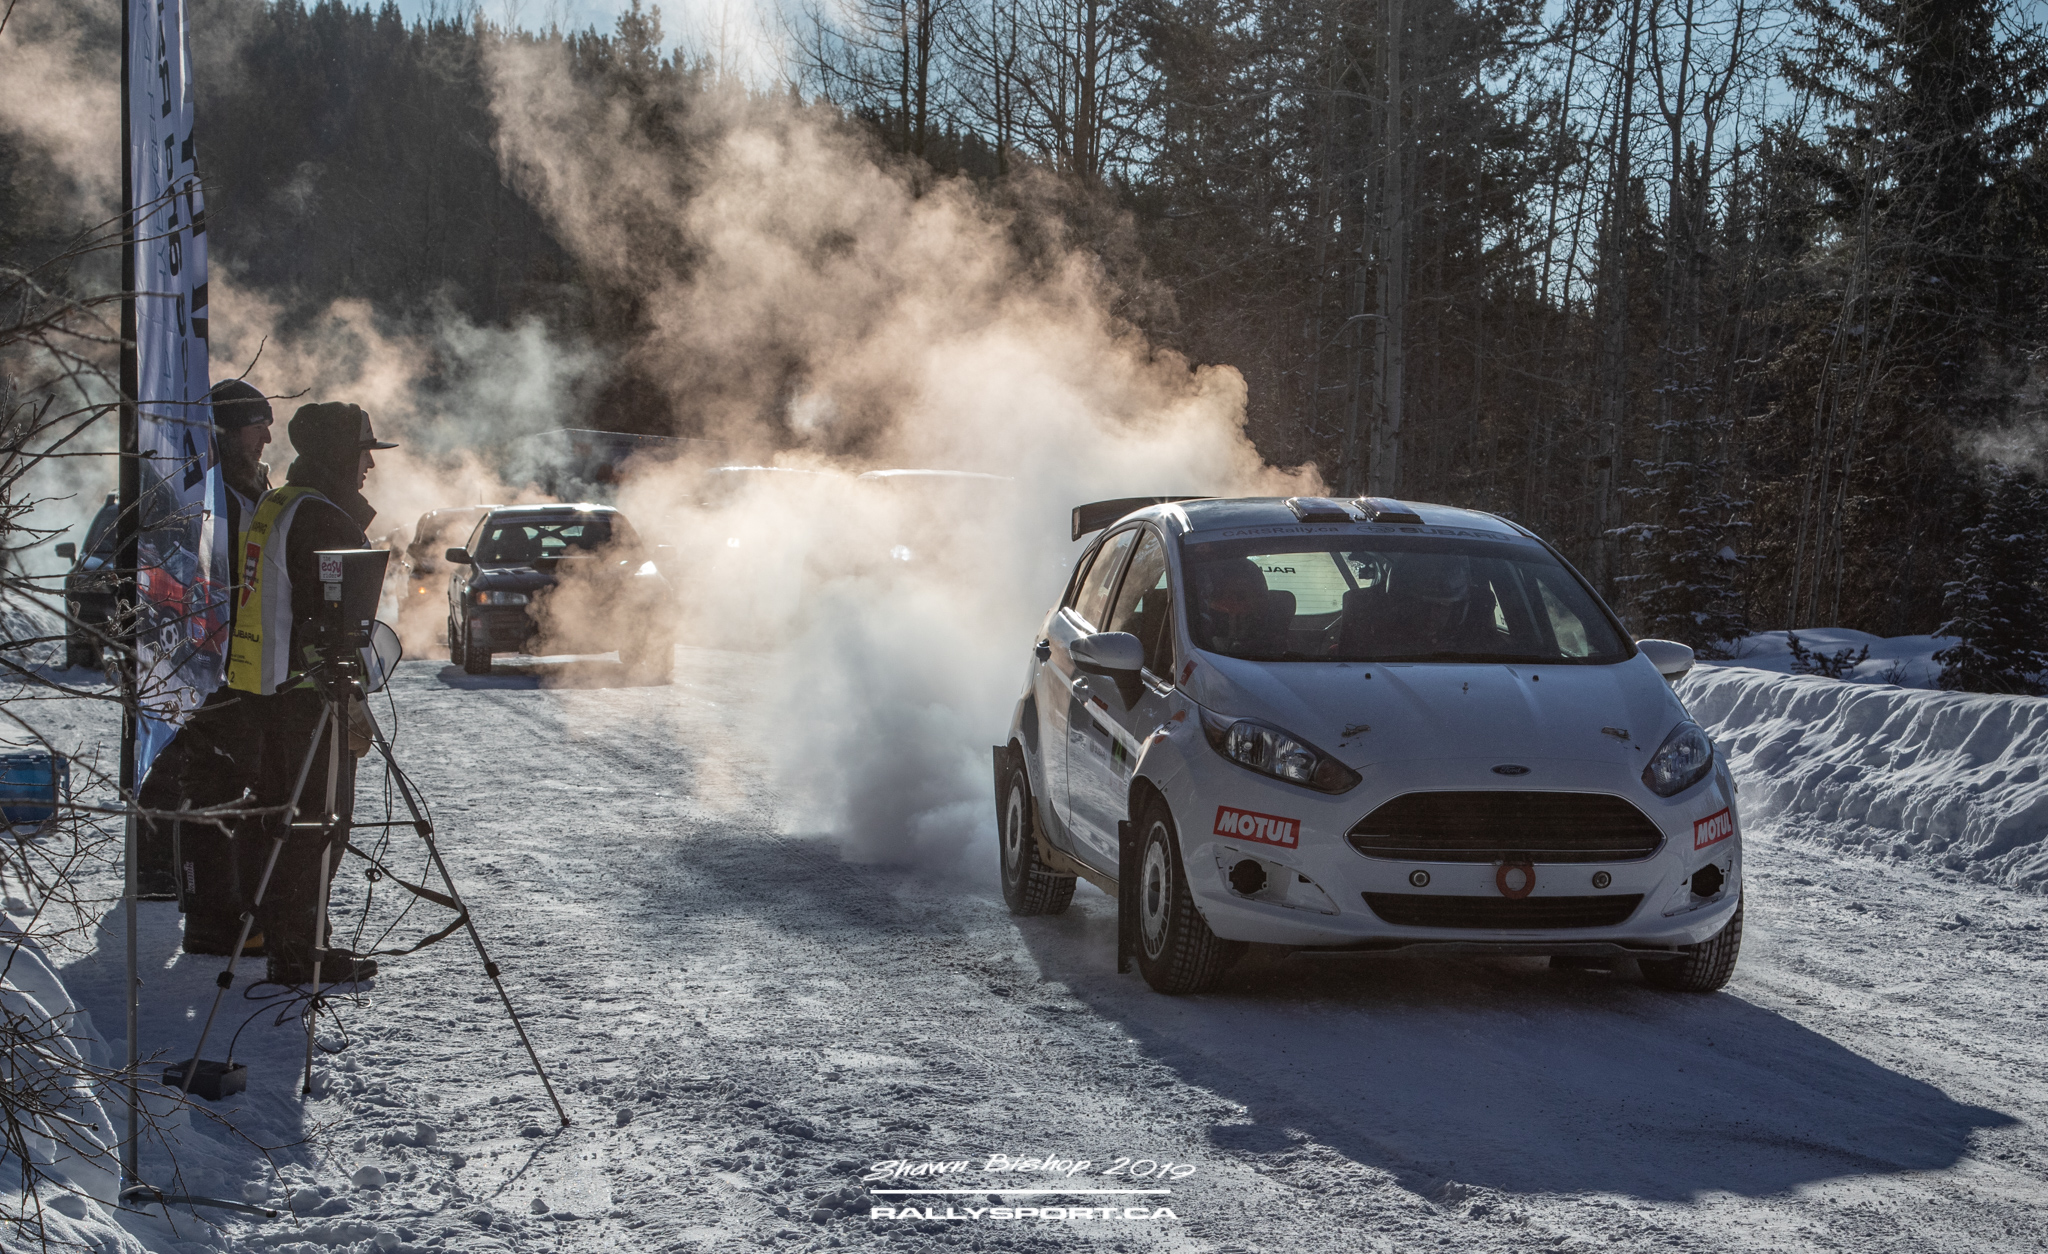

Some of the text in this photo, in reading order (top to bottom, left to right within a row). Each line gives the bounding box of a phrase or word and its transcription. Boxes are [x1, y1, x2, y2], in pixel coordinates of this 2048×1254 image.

[1222, 525, 1339, 537] CARSRally.ca
[1398, 526, 1512, 541] SUBARU
[321, 560, 342, 577] easy
[1217, 810, 1295, 845] MOTUL
[1696, 810, 1732, 846] MOTUL
